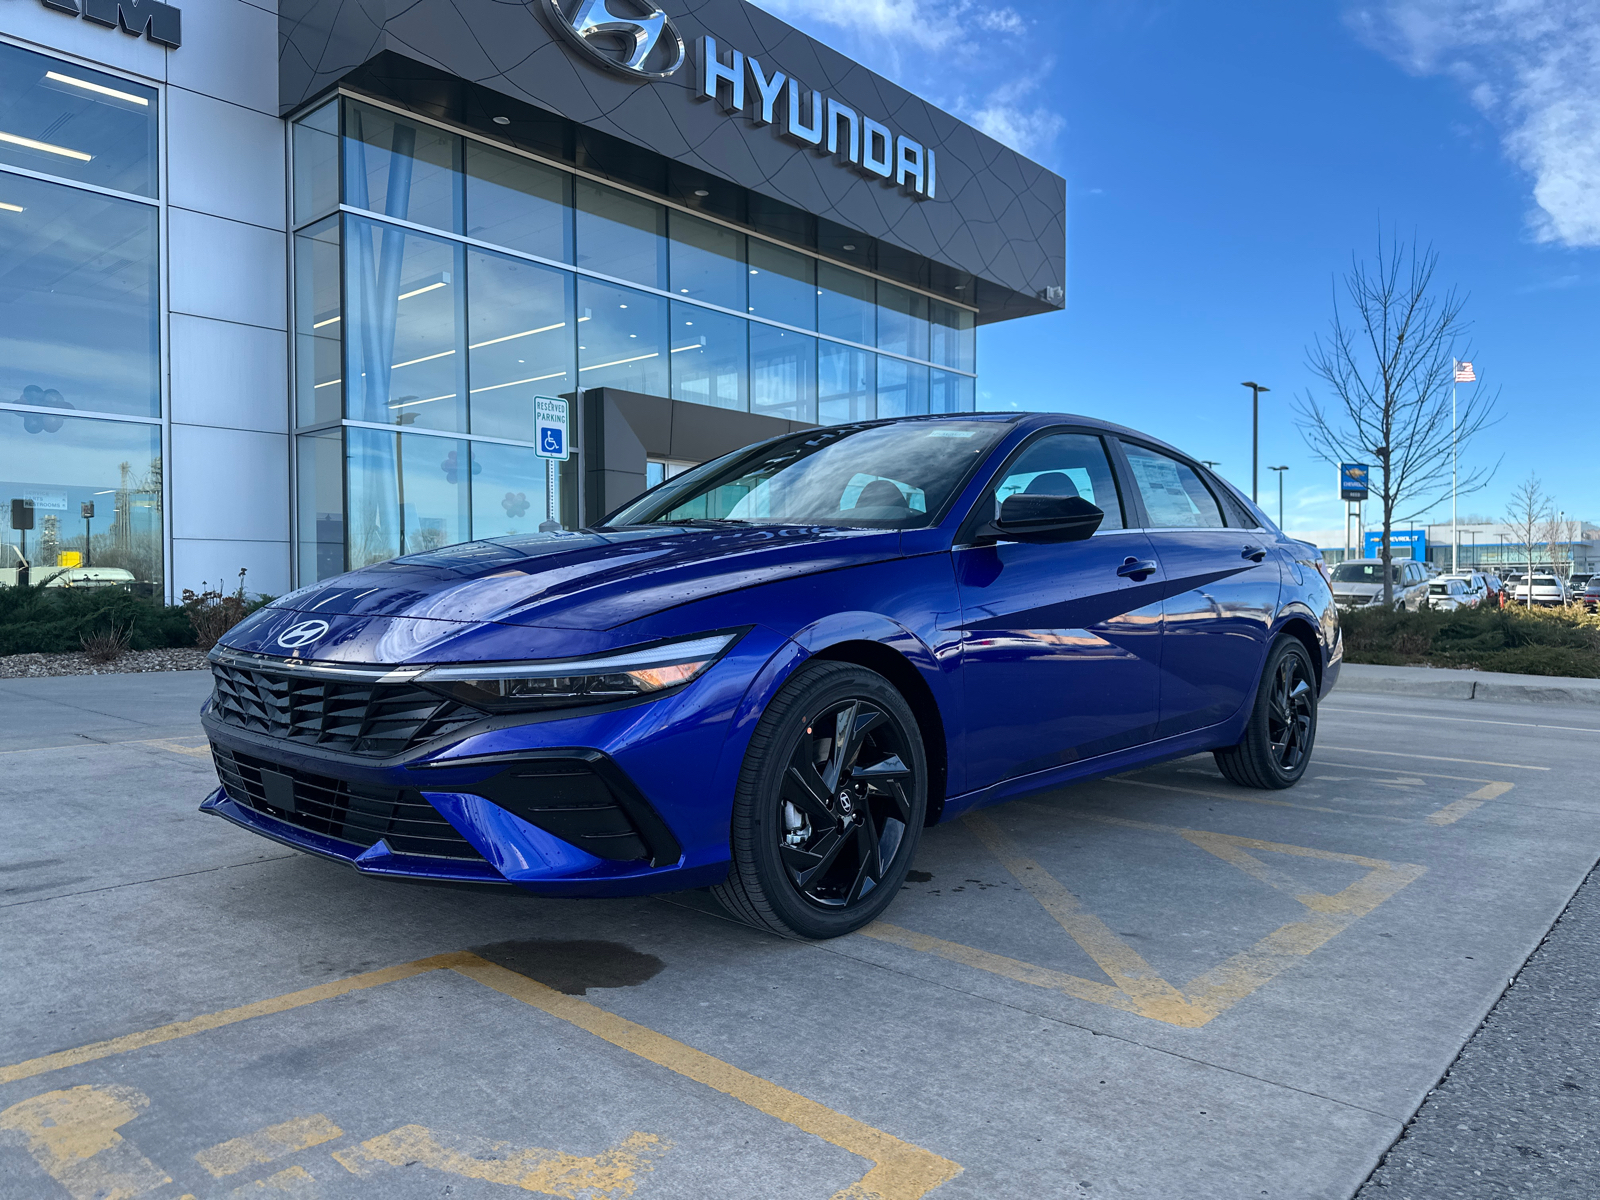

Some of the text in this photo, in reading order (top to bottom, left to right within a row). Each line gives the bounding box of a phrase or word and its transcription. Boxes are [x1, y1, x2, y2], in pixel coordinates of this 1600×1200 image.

[701, 35, 936, 199] HYUNDAI
[537, 402, 565, 413] RESERVED
[537, 412, 565, 423] PARKING
